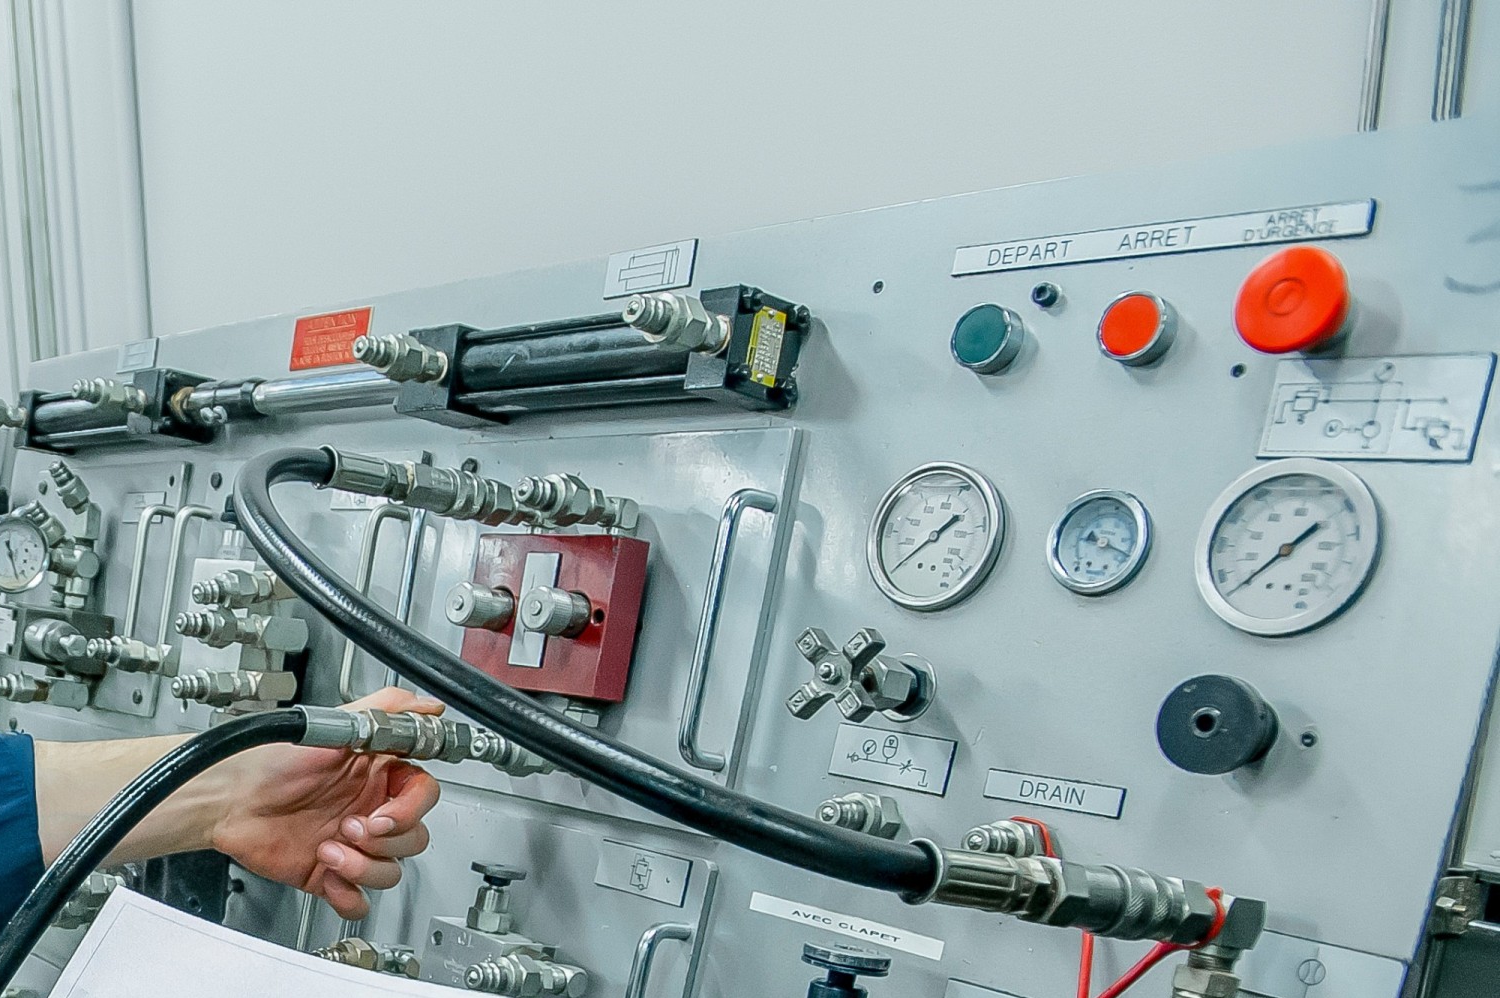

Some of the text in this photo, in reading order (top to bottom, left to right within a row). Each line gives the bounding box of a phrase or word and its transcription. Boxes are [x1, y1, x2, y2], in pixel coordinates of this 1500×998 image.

[1266, 207, 1321, 227] ARRET
[1242, 219, 1338, 242] D'URGENCE
[987, 226, 1197, 267] DEPART ARRET
[1019, 780, 1086, 806] DRAIN
[792, 910, 901, 943] AVEC CLAPET
